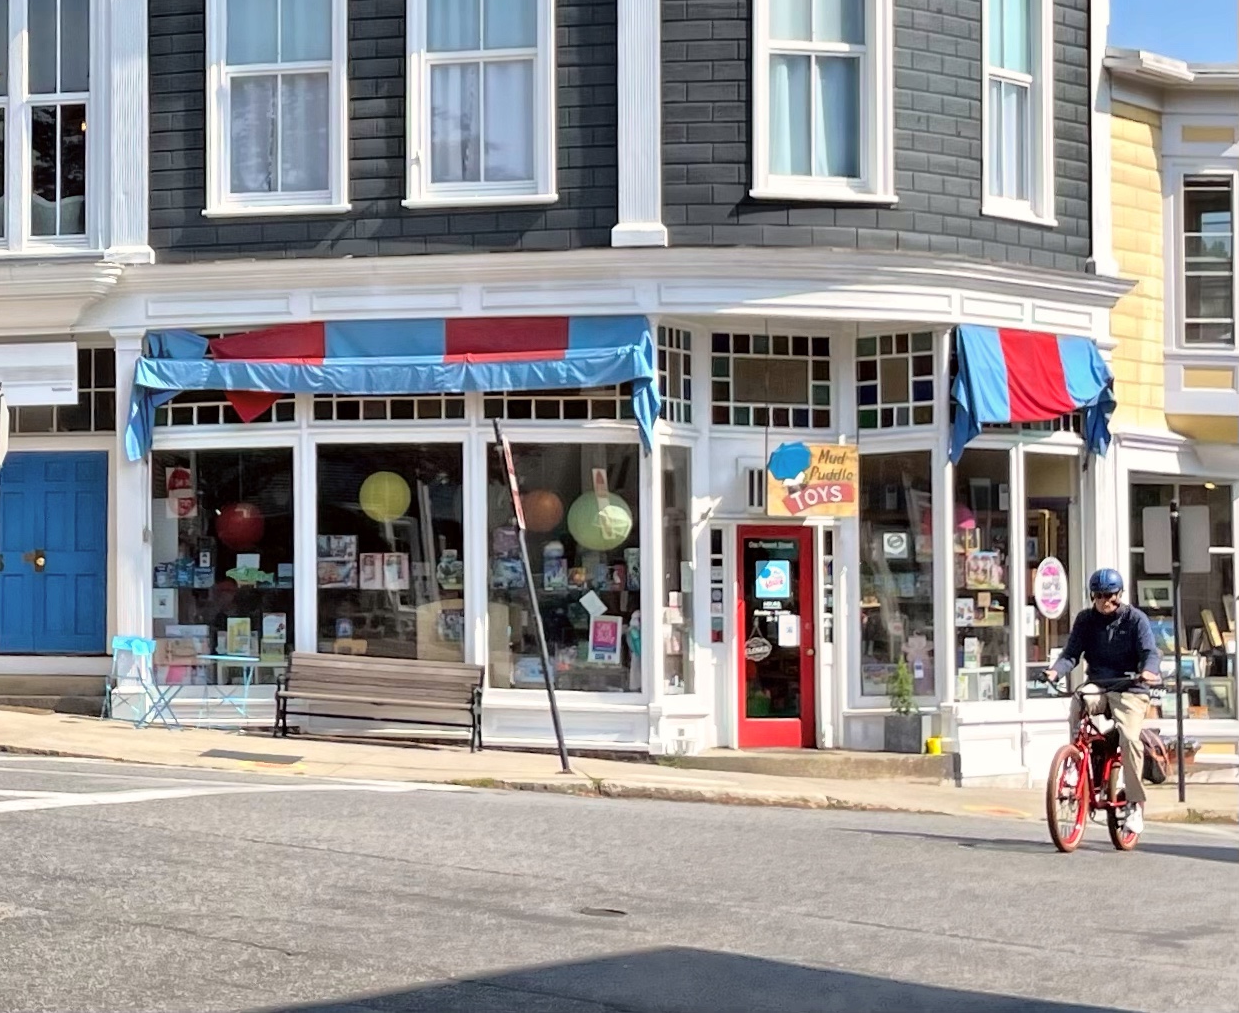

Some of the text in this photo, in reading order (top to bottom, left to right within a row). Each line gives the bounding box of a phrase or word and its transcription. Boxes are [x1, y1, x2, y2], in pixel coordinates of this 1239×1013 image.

[818, 449, 846, 465] Mud
[809, 465, 854, 481] Puddle
[790, 485, 843, 510] TOYS
